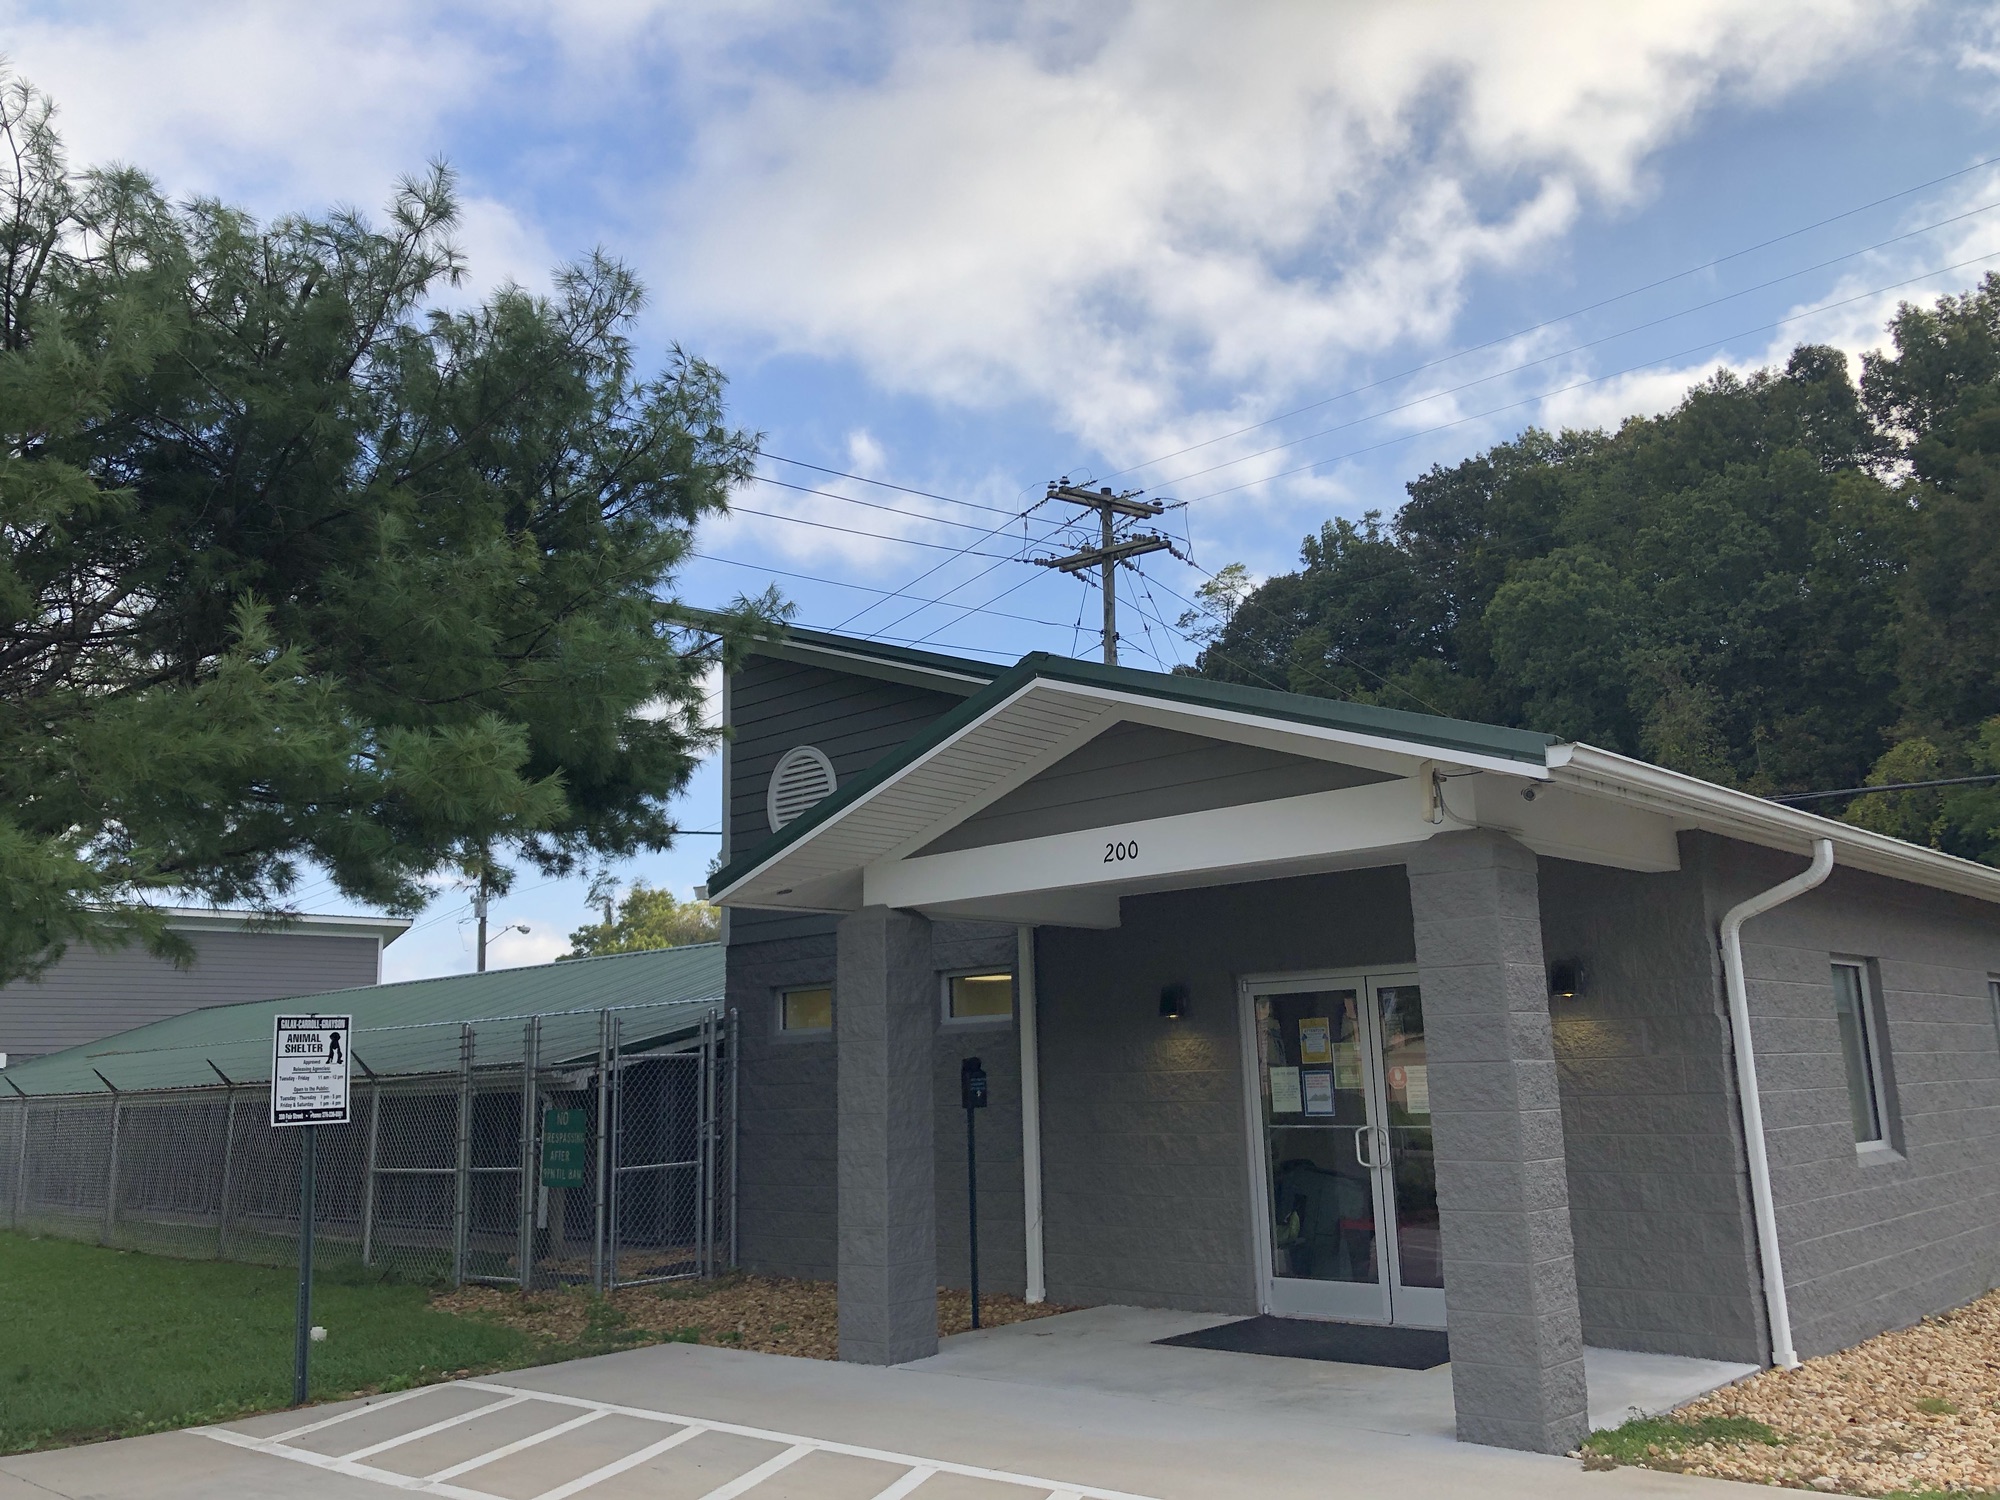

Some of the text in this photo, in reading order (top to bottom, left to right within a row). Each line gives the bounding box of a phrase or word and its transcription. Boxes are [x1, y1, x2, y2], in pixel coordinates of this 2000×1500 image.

[1103, 840, 1139, 864] 200
[287, 1033, 321, 1043] ANIMAL
[285, 1043, 323, 1053] SHELTER
[556, 1111, 569, 1126] NO
[550, 1150, 570, 1161] AFTER
